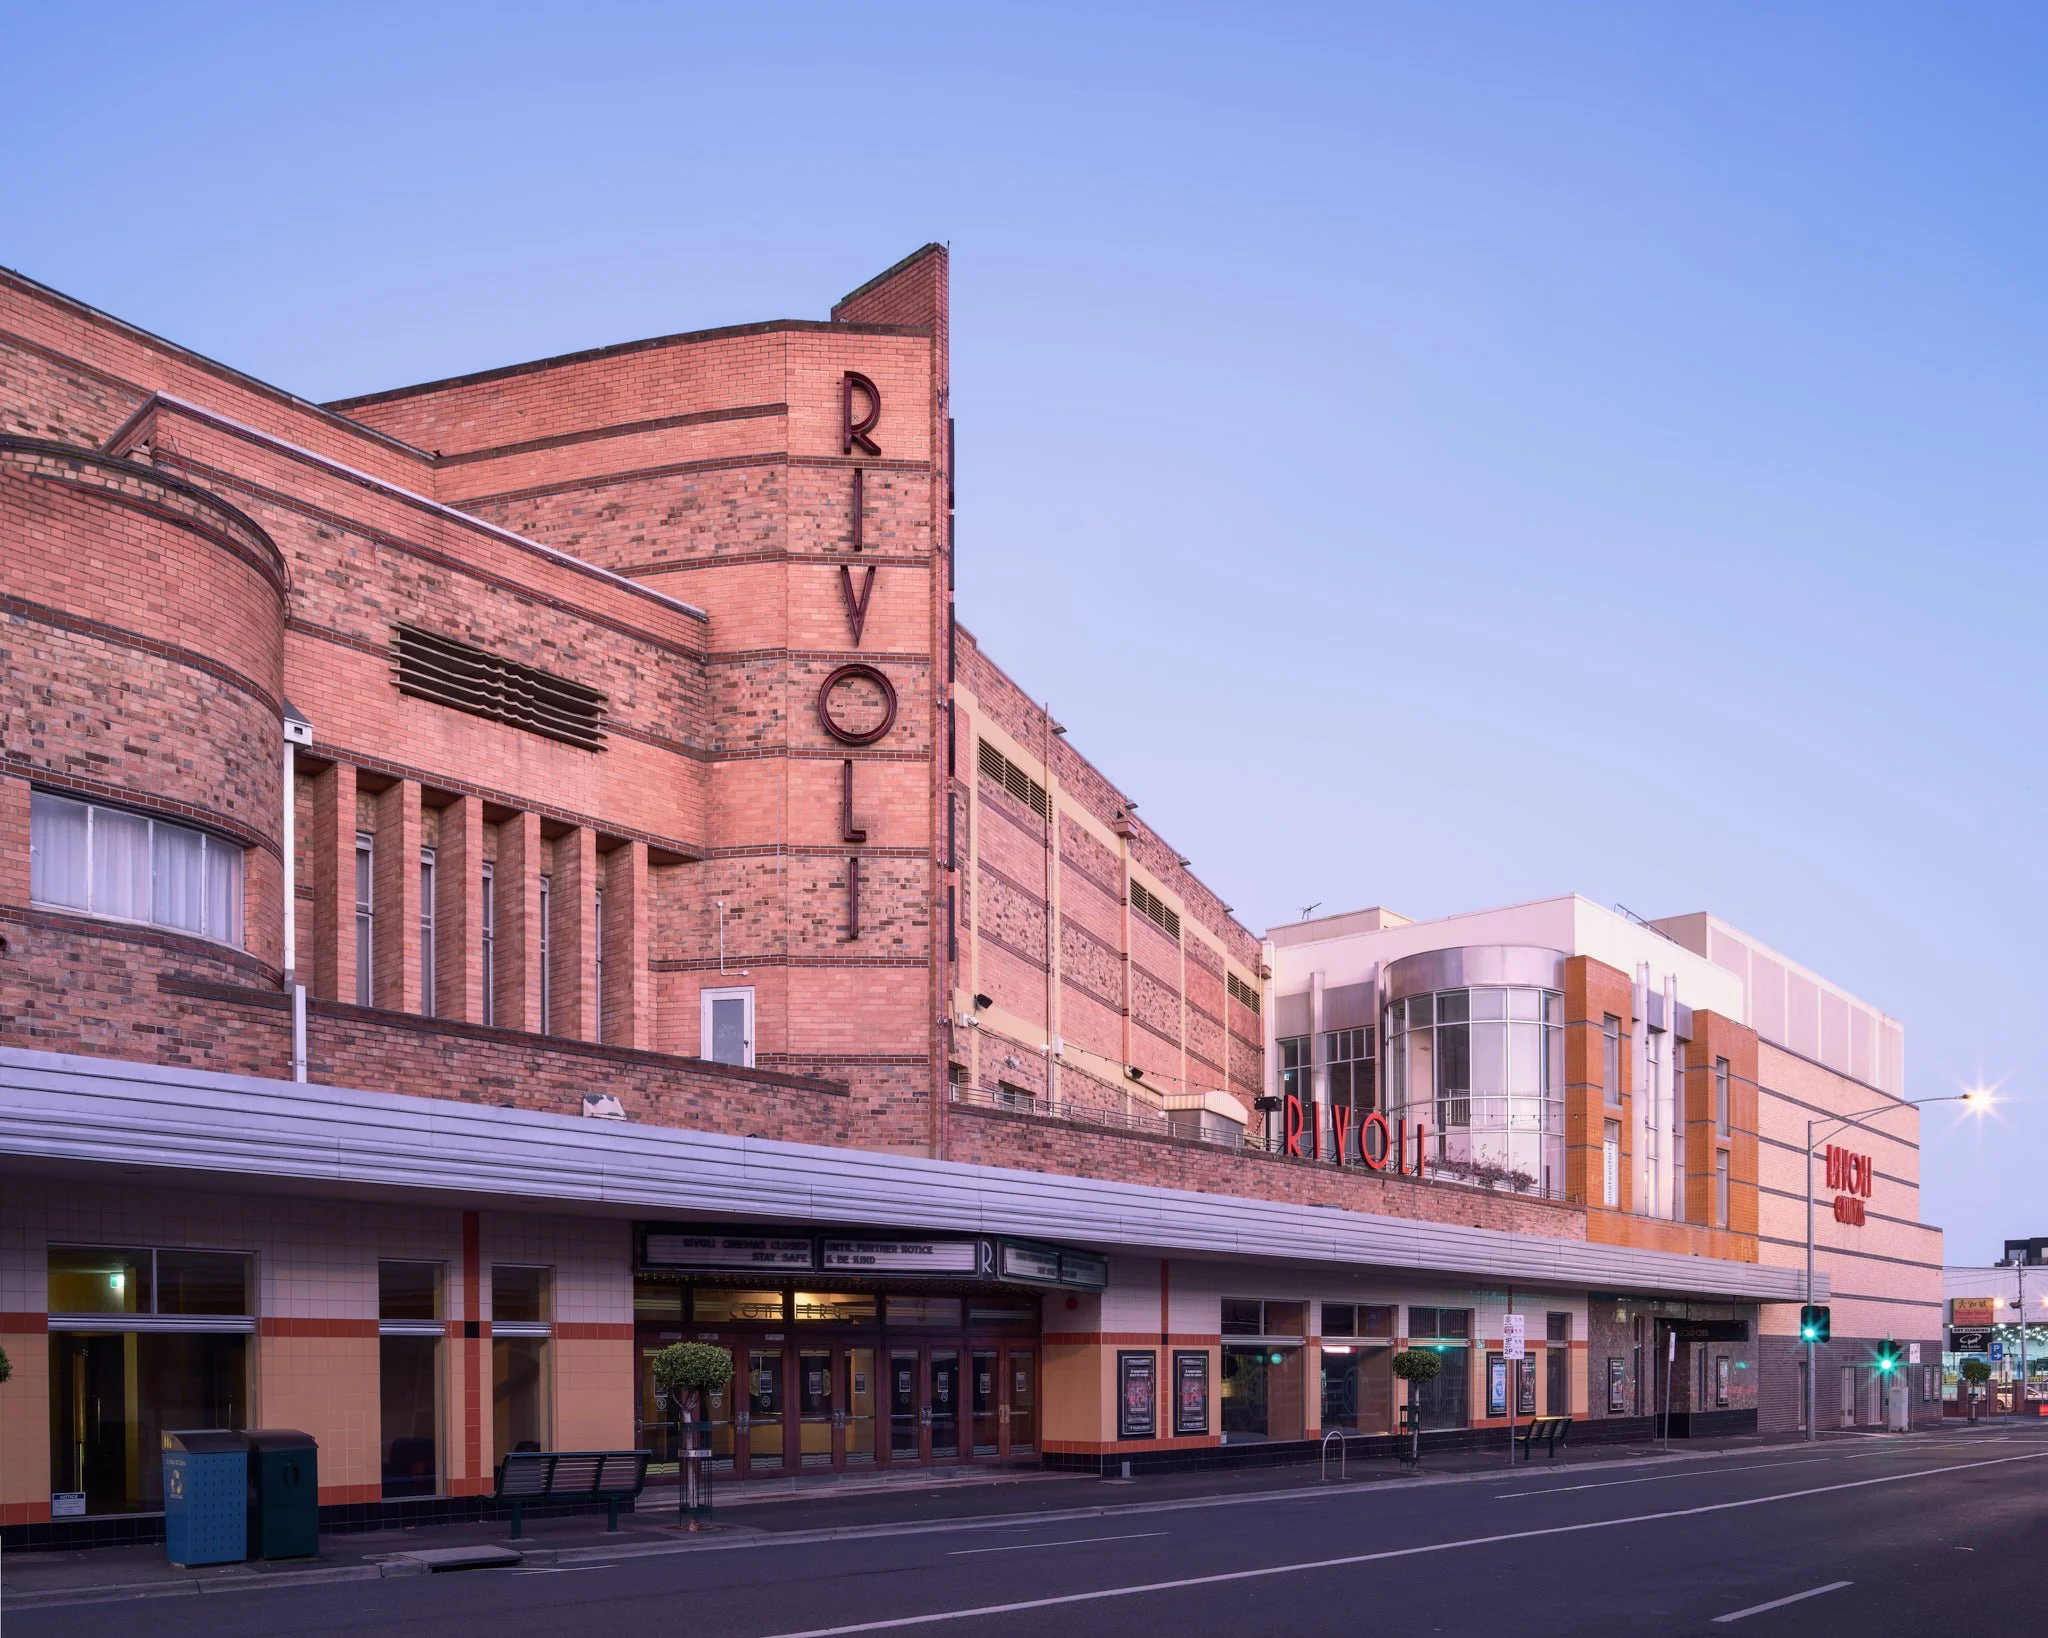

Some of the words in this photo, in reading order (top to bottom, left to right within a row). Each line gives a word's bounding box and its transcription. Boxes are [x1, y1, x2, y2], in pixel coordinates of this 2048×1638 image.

[818, 370, 898, 941] RIVOLI
[1283, 1094, 1424, 1177] RIVOLI
[683, 1238, 716, 1248] RIVOLI
[722, 1239, 765, 1249] CINEMAS
[770, 1240, 808, 1250] CLOSED
[826, 1243, 853, 1252] UNTIL
[857, 1244, 897, 1253] FURTHER
[901, 1245, 933, 1254] NOTICE
[751, 1252, 776, 1261] STAY
[782, 1253, 808, 1262] SAFE
[837, 1256, 850, 1264] BE
[853, 1256, 876, 1264] KIND
[982, 1241, 993, 1273] R
